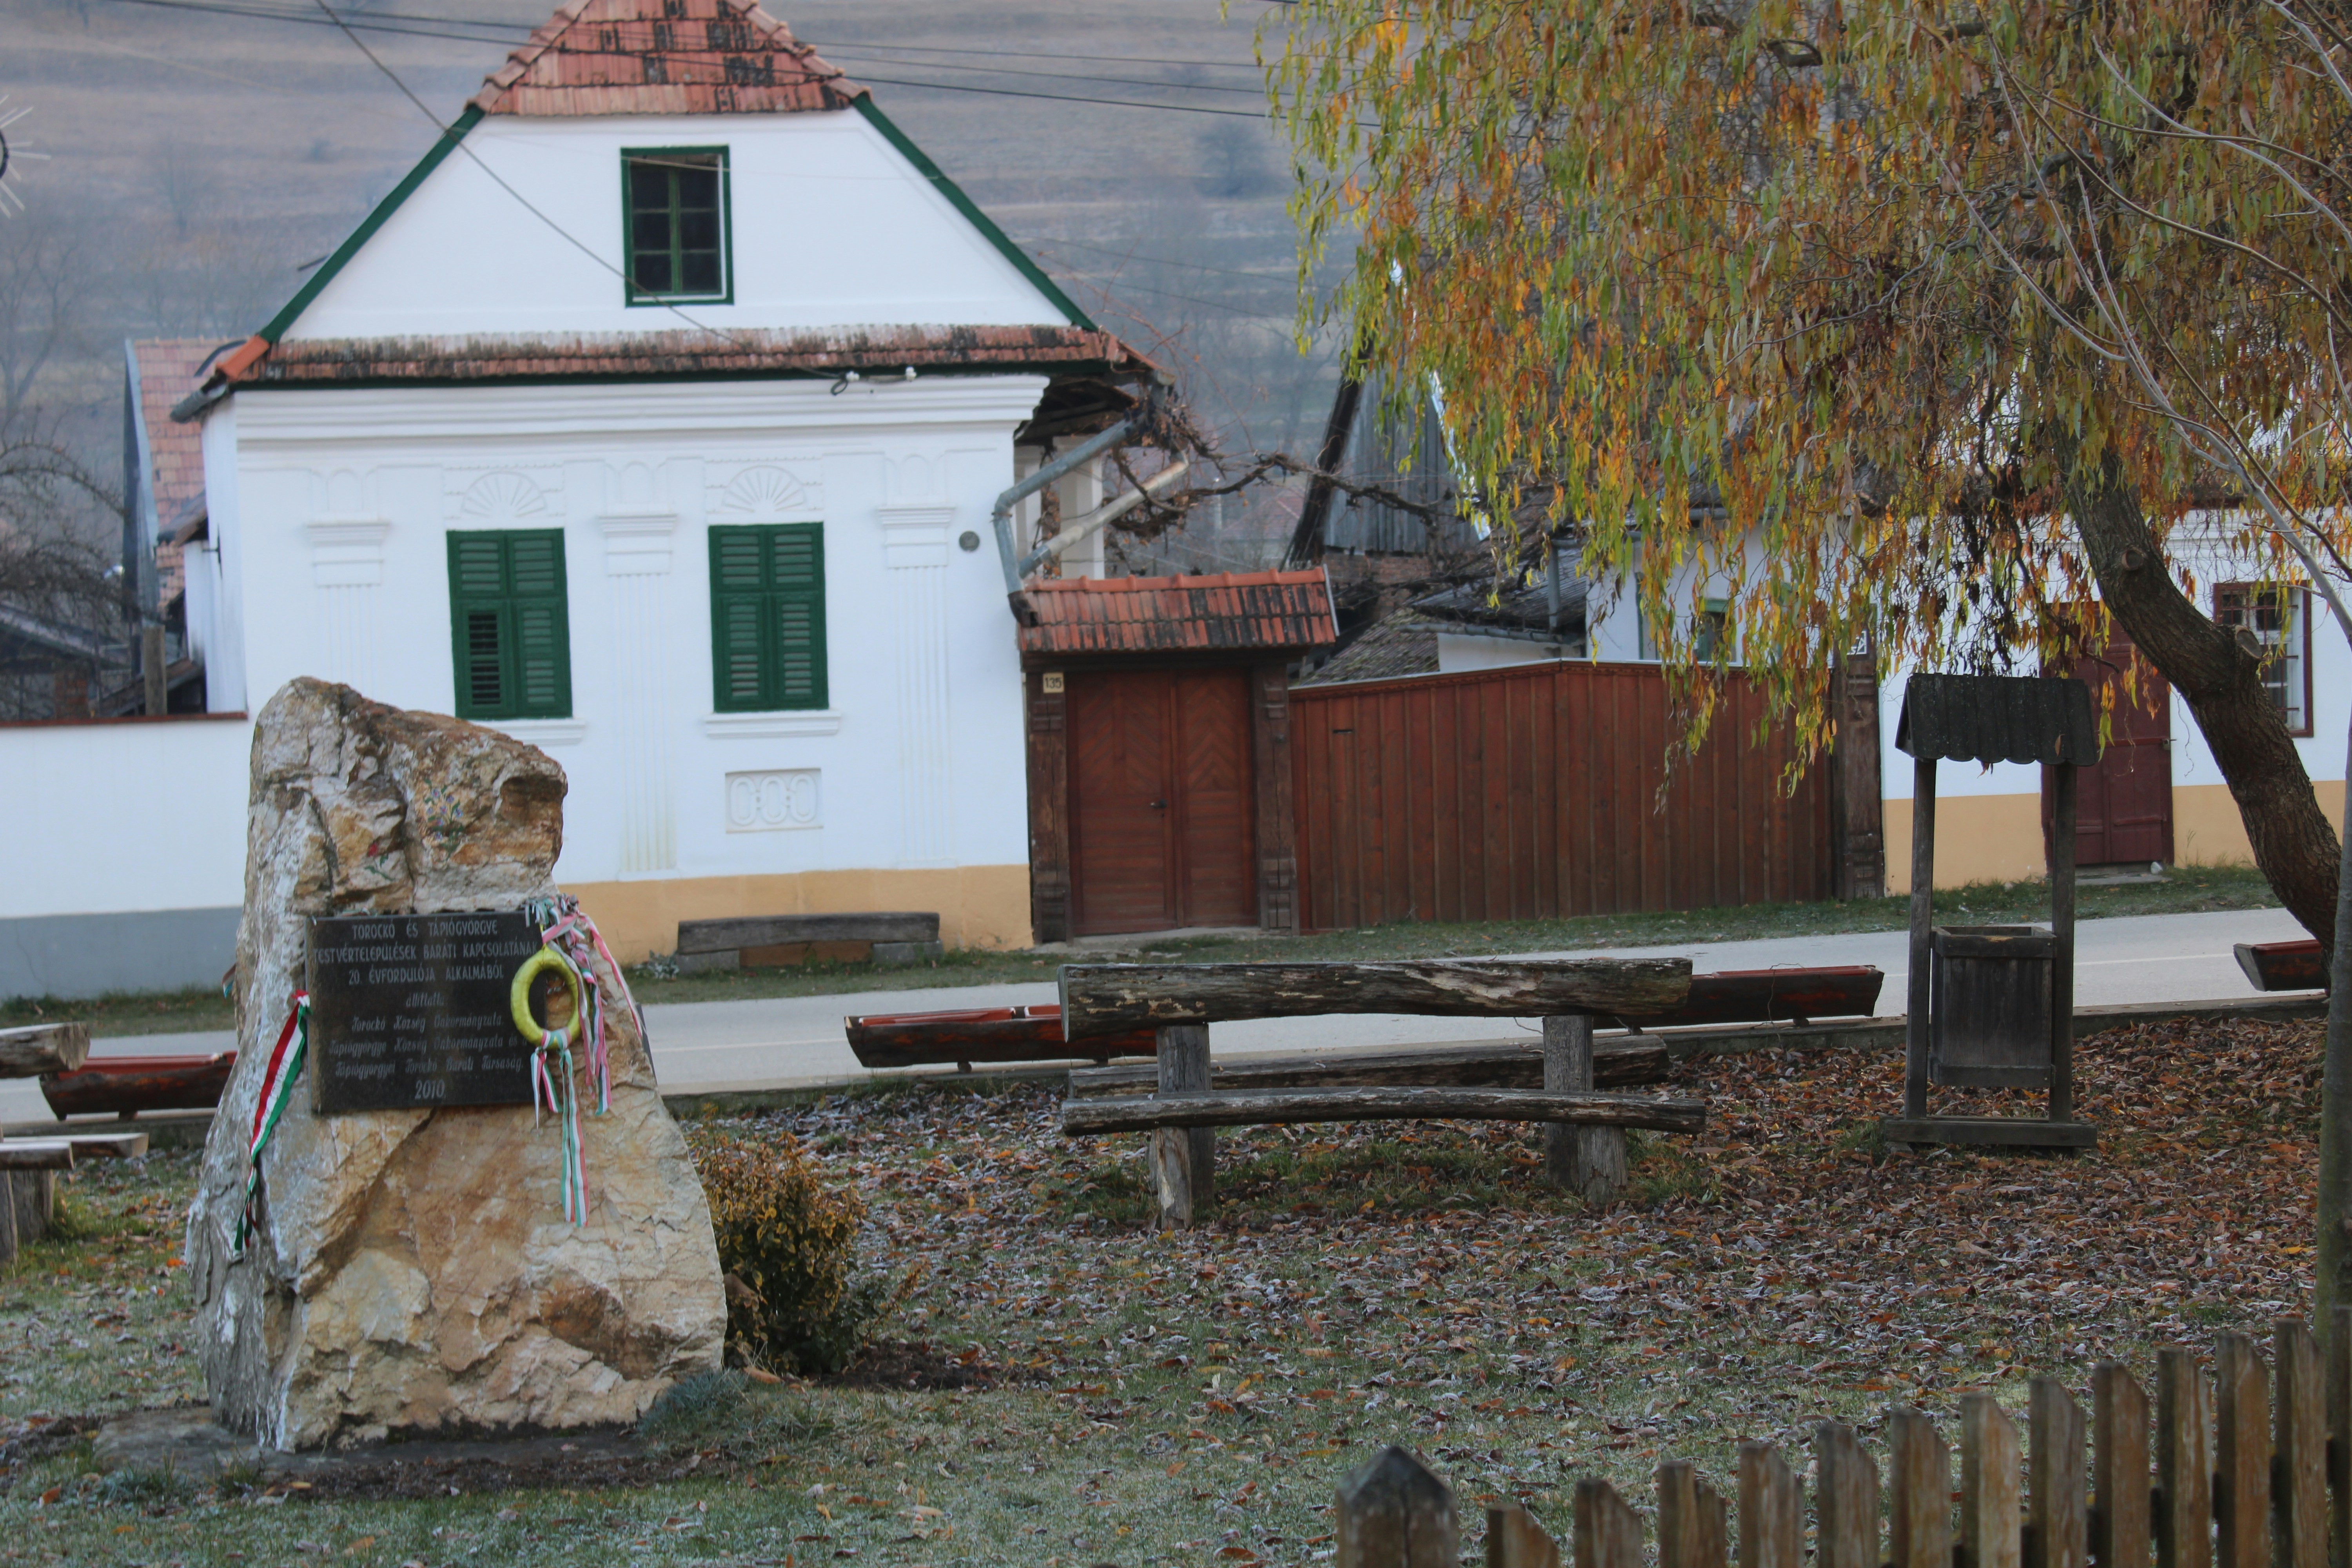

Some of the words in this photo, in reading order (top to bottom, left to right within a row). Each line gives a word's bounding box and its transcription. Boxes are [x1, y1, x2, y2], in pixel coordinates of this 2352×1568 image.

[1045, 677, 1062, 688] 135
[352, 918, 395, 939] TOROCKÓ
[407, 918, 418, 937] ÉS
[428, 917, 497, 936] TÁPIÓGYÖRGYE
[314, 942, 416, 962] TESTVÉRTELEPÜLÉSEK
[424, 939, 456, 959] BARÁTI
[463, 936, 537, 957] KAPCSOLATÁNAK
[369, 964, 435, 984] ÉVFORDULÓJA
[446, 960, 503, 981] ALKALMÁBÓL
[352, 1015, 385, 1031] Torockó
